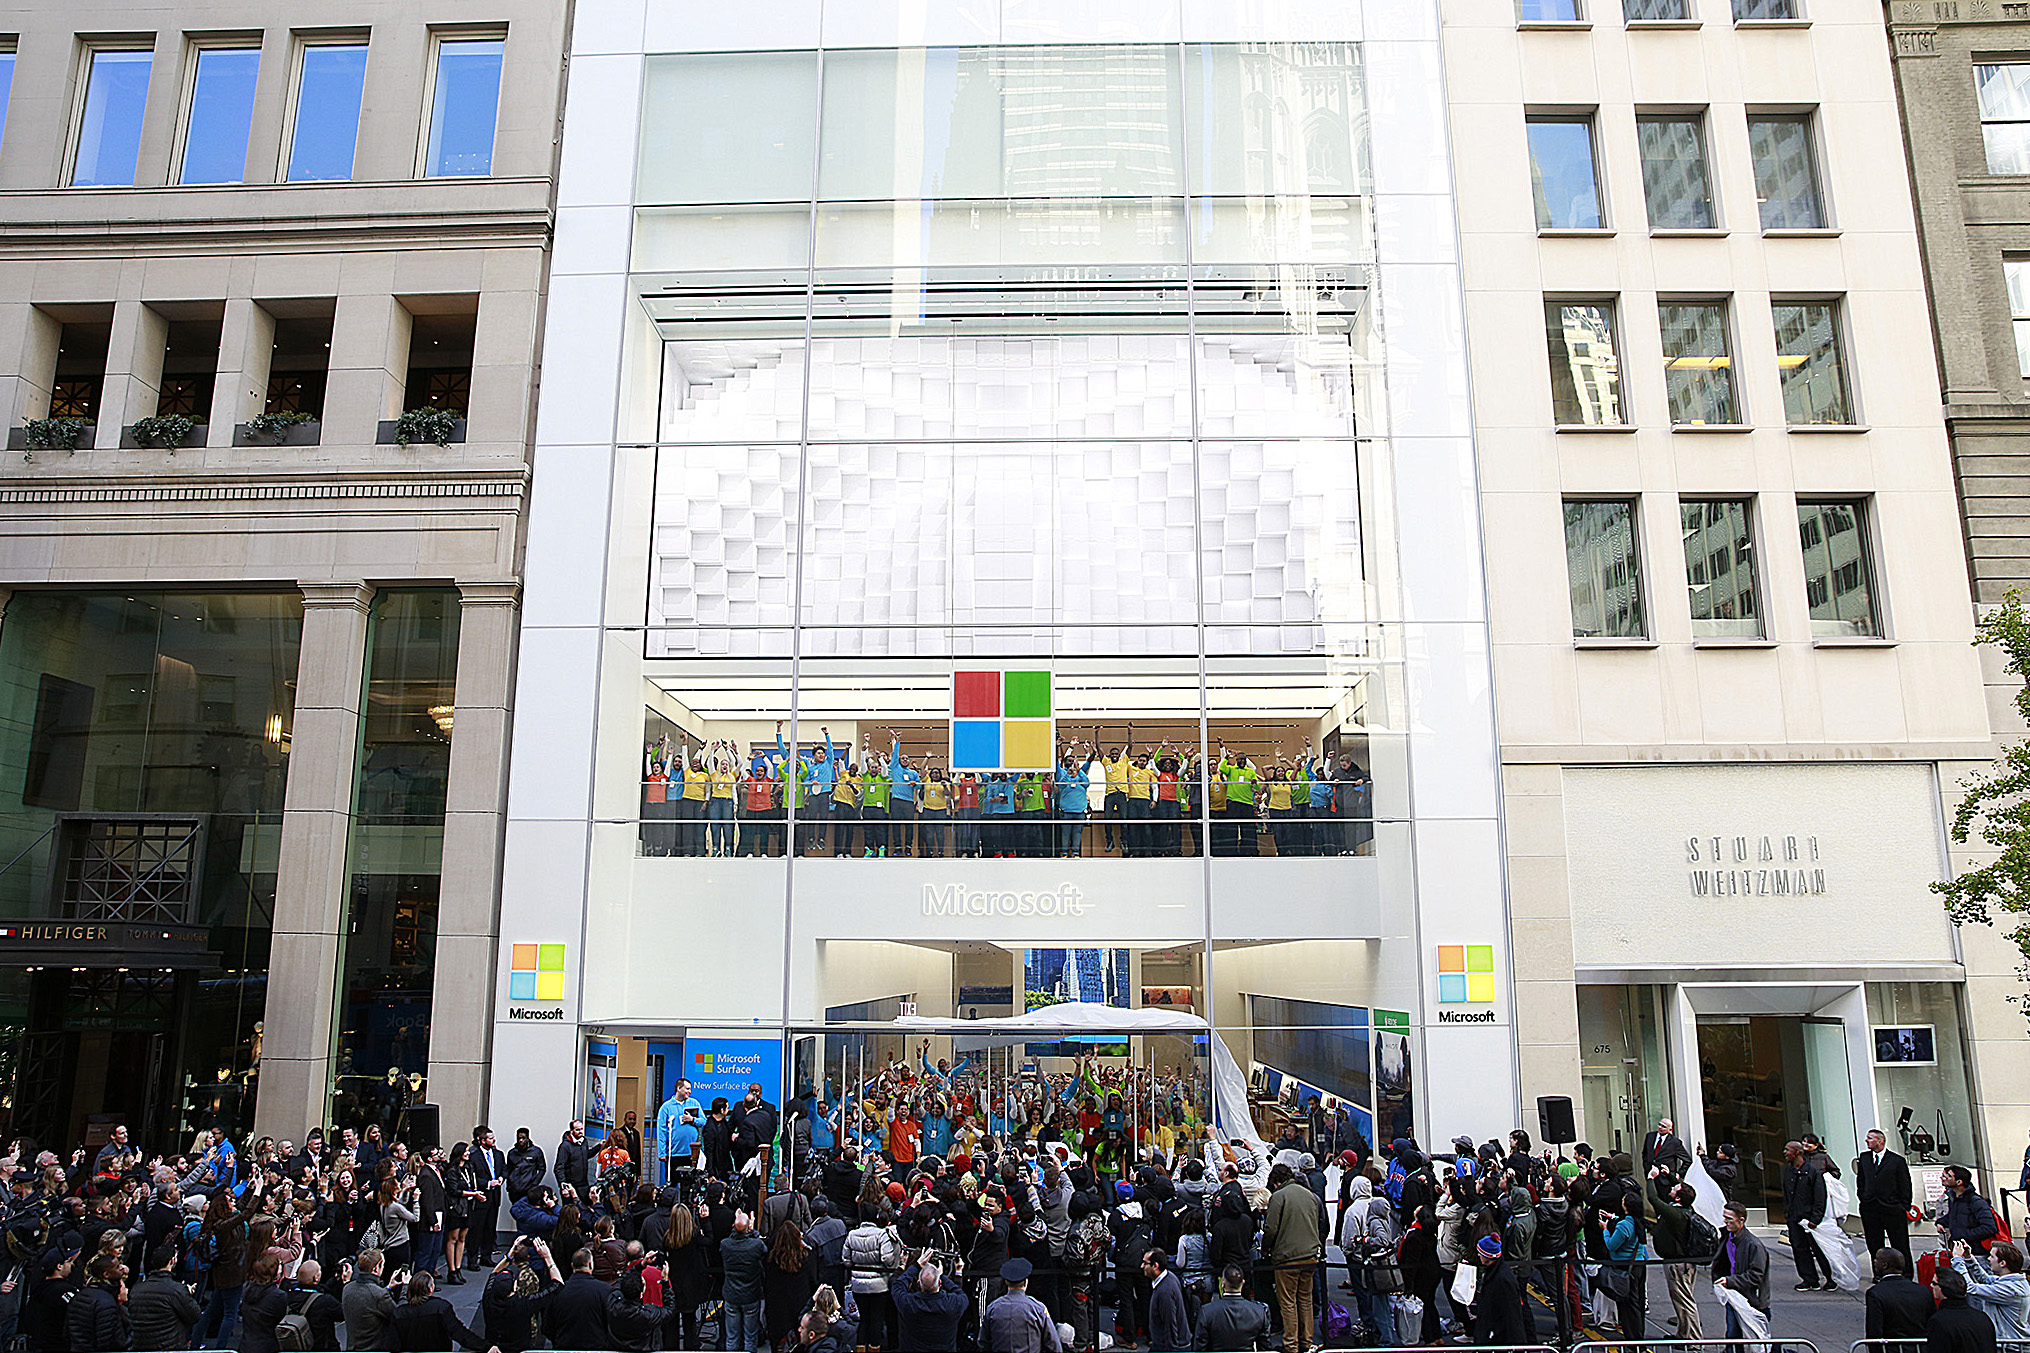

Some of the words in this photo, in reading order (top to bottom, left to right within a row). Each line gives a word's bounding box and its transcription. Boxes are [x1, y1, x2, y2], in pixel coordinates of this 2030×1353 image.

[1692, 868, 1827, 896] WEITZMAN
[923, 884, 1082, 915] Microsoft
[21, 926, 107, 940] HILFIGER
[509, 1007, 564, 1020] Microsoft
[1438, 1010, 1496, 1023] Microsoft
[1594, 1044, 1611, 1053] 675
[717, 1053, 761, 1064] Microsoft
[716, 1064, 752, 1074] Surface
[693, 1081, 711, 1090] New
[712, 1081, 741, 1091] Surface
